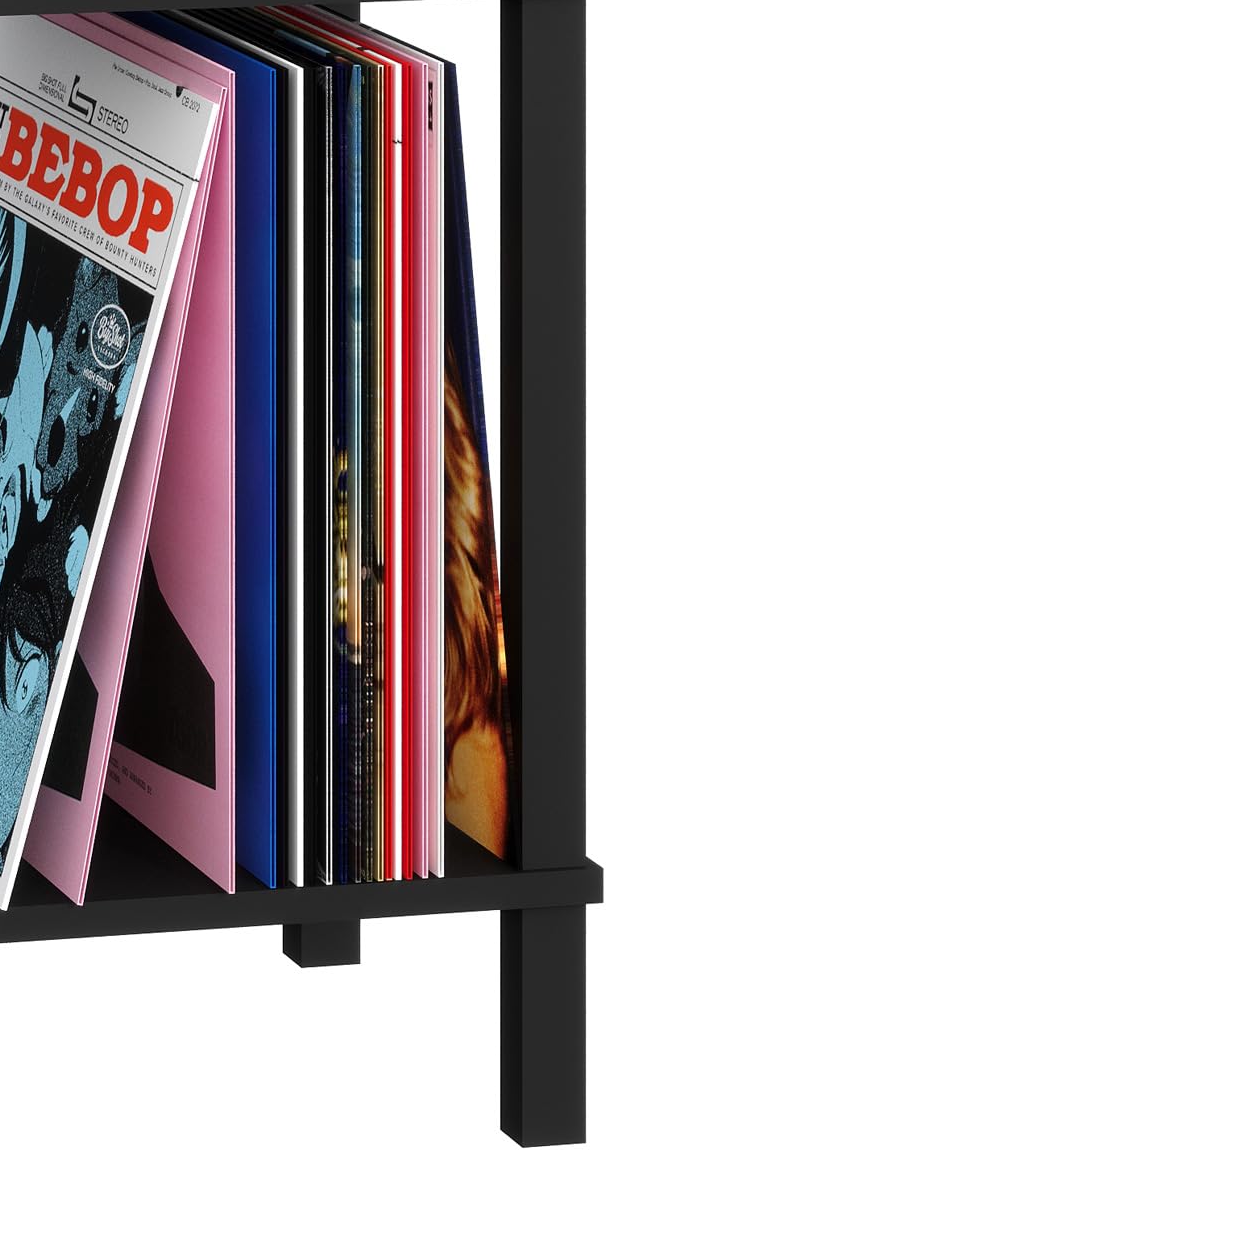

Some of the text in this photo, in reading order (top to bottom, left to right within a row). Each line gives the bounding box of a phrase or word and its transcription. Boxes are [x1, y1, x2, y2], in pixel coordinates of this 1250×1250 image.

[97, 106, 129, 134] STEREO
[4, 182, 12, 193] BY
[13, 186, 23, 201] THE
[24, 194, 51, 216] GALAXY'S
[51, 209, 78, 232] FAVORITE
[79, 225, 94, 241] CREW
[96, 235, 104, 246] OF
[105, 240, 128, 261] BOUNTY
[130, 254, 157, 277] HUNTERS
[83, 367, 116, 394] HIGH FIDELITY
